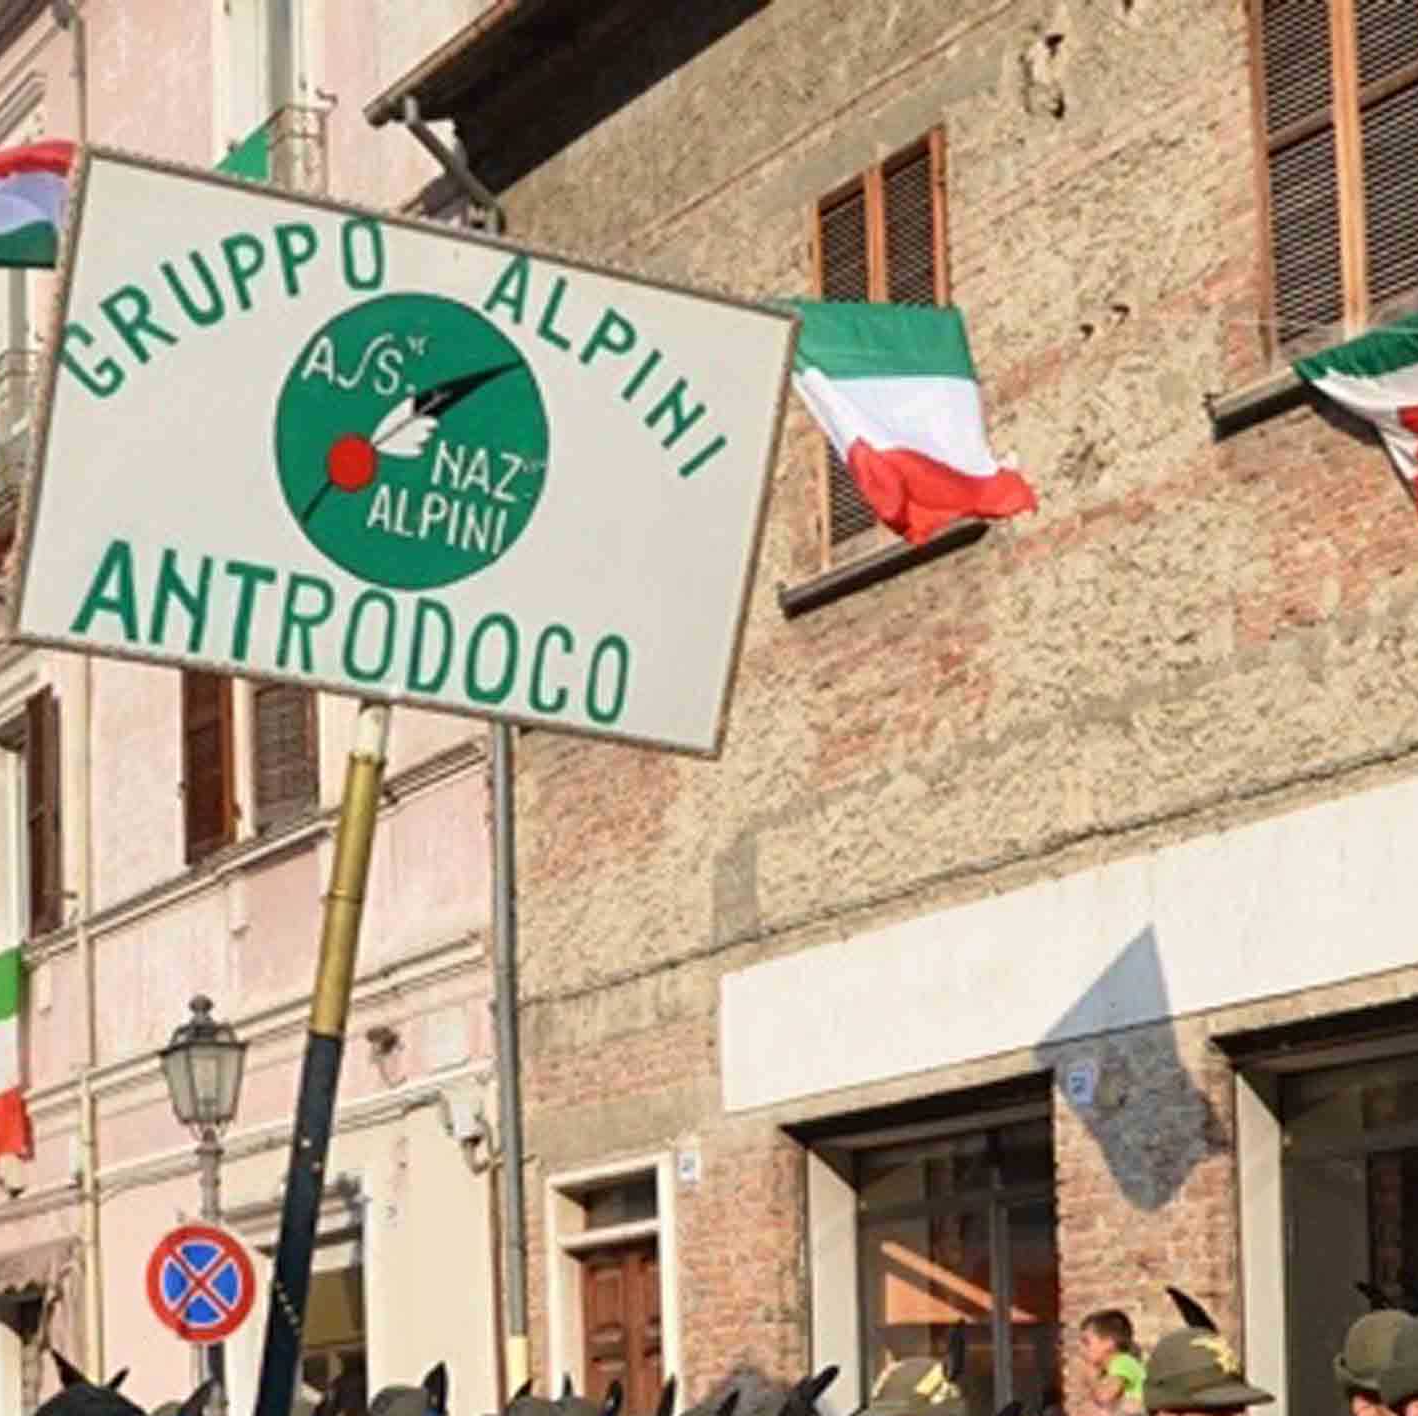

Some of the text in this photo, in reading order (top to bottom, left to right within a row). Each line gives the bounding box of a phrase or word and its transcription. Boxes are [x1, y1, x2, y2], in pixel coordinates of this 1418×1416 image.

[59, 216, 728, 479] GRUPPO ALPINI
[366, 483, 507, 555] ALPINI
[70, 539, 633, 726] ANTRODOCO
